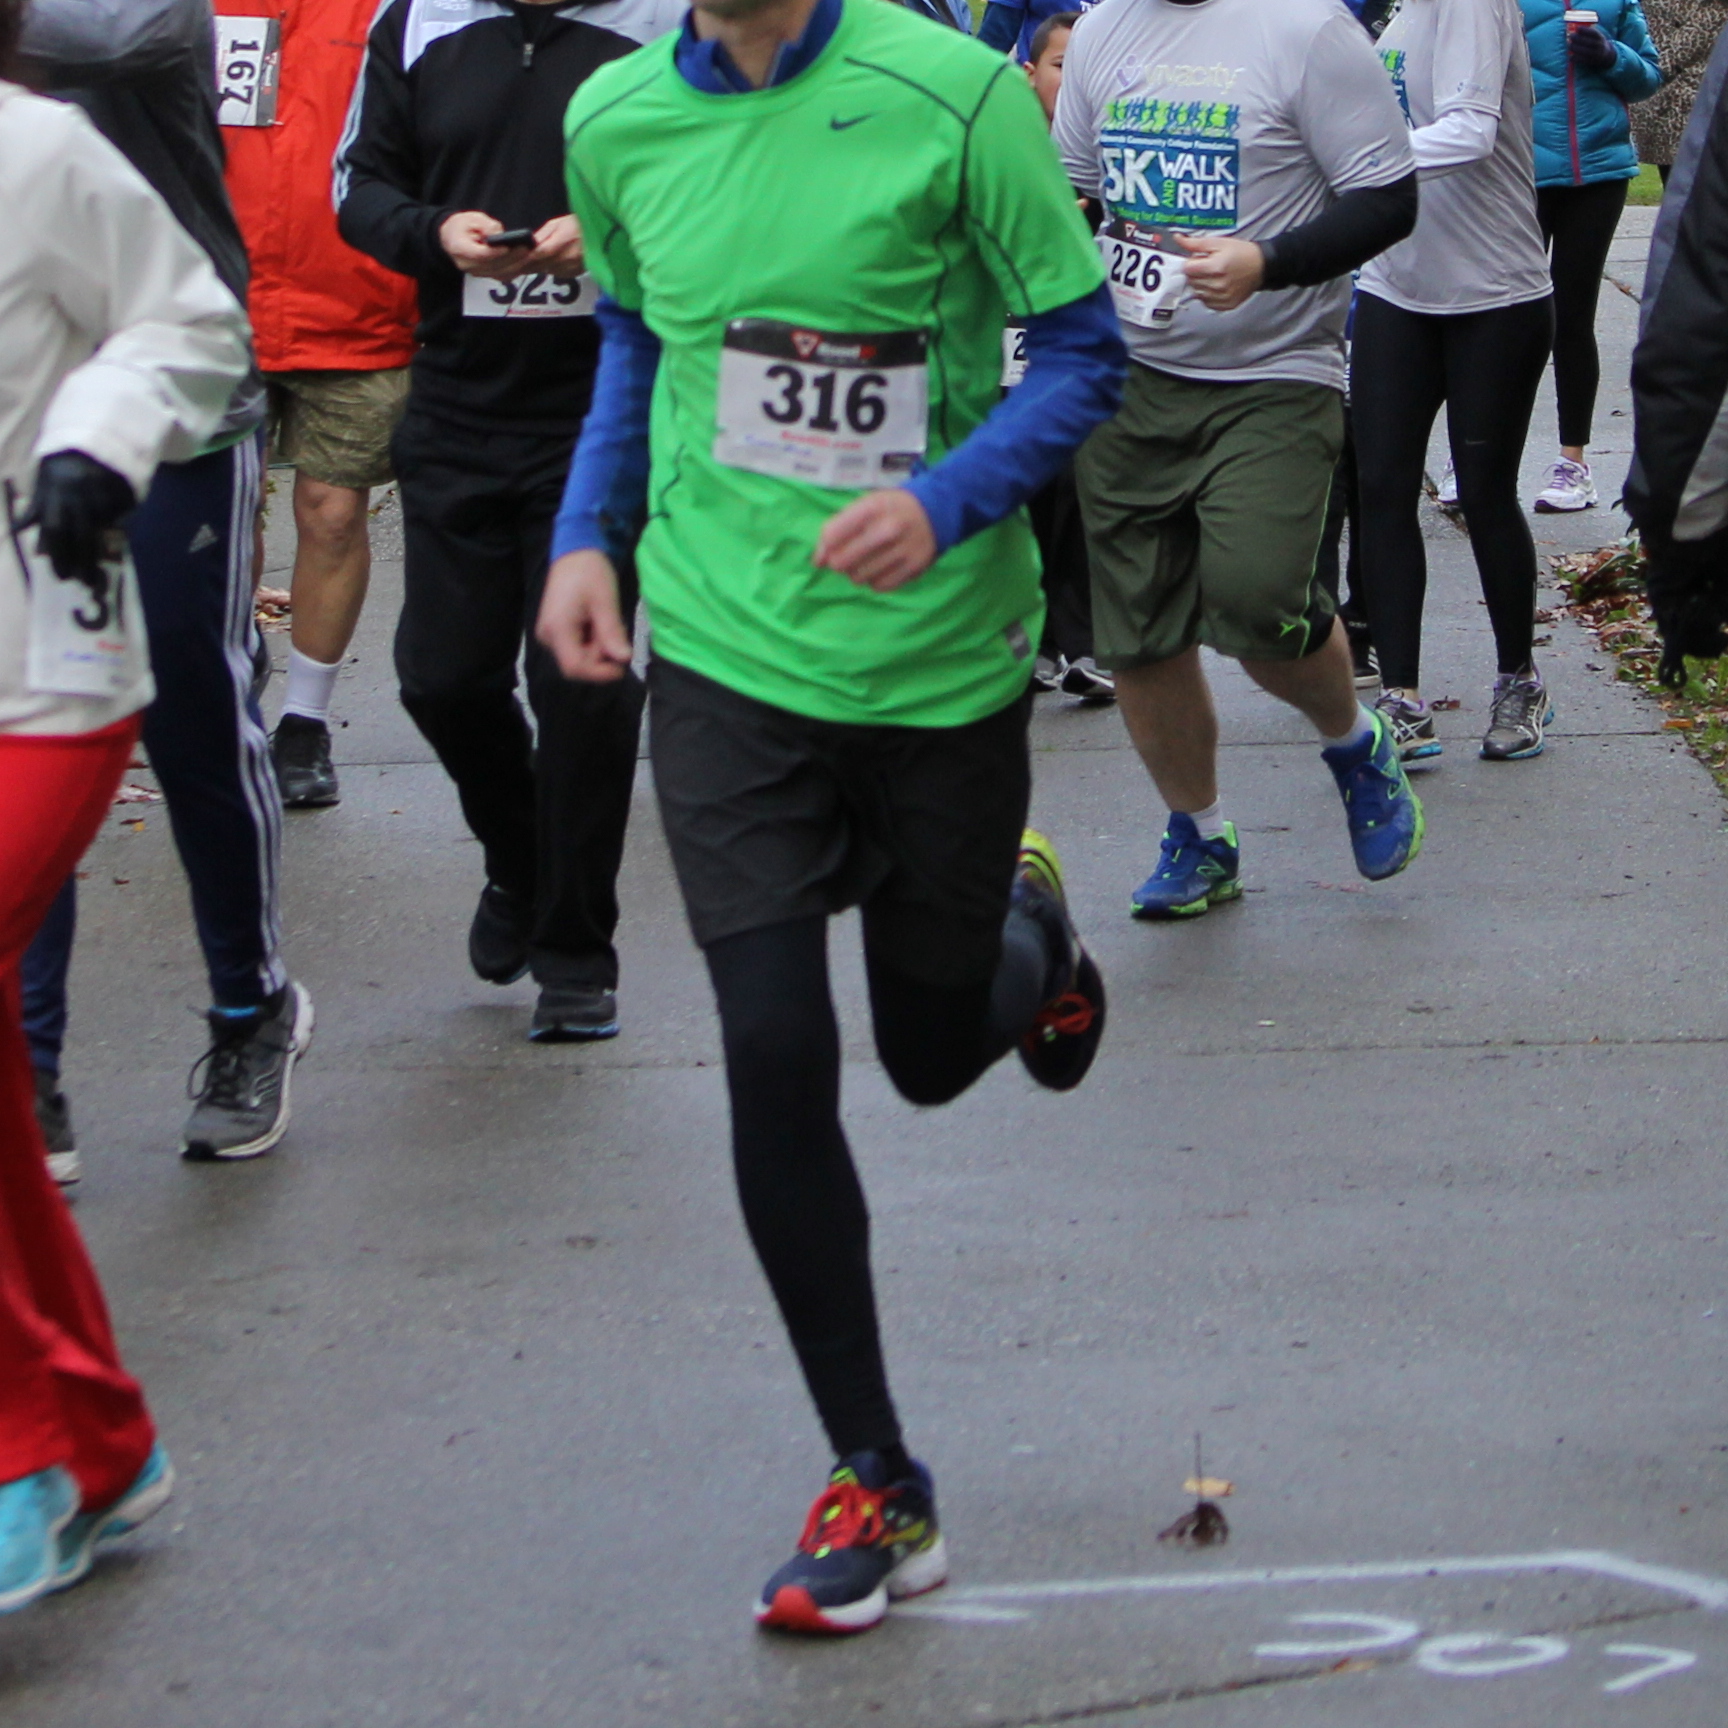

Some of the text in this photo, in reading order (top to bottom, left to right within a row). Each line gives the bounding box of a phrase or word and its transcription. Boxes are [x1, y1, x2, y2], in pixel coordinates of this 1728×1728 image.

[224, 39, 260, 106] 167
[1102, 147, 1235, 208] 5K WALK
[1161, 179, 1236, 211] AND RUN
[1110, 243, 1166, 293] 226
[761, 363, 889, 435] 316
